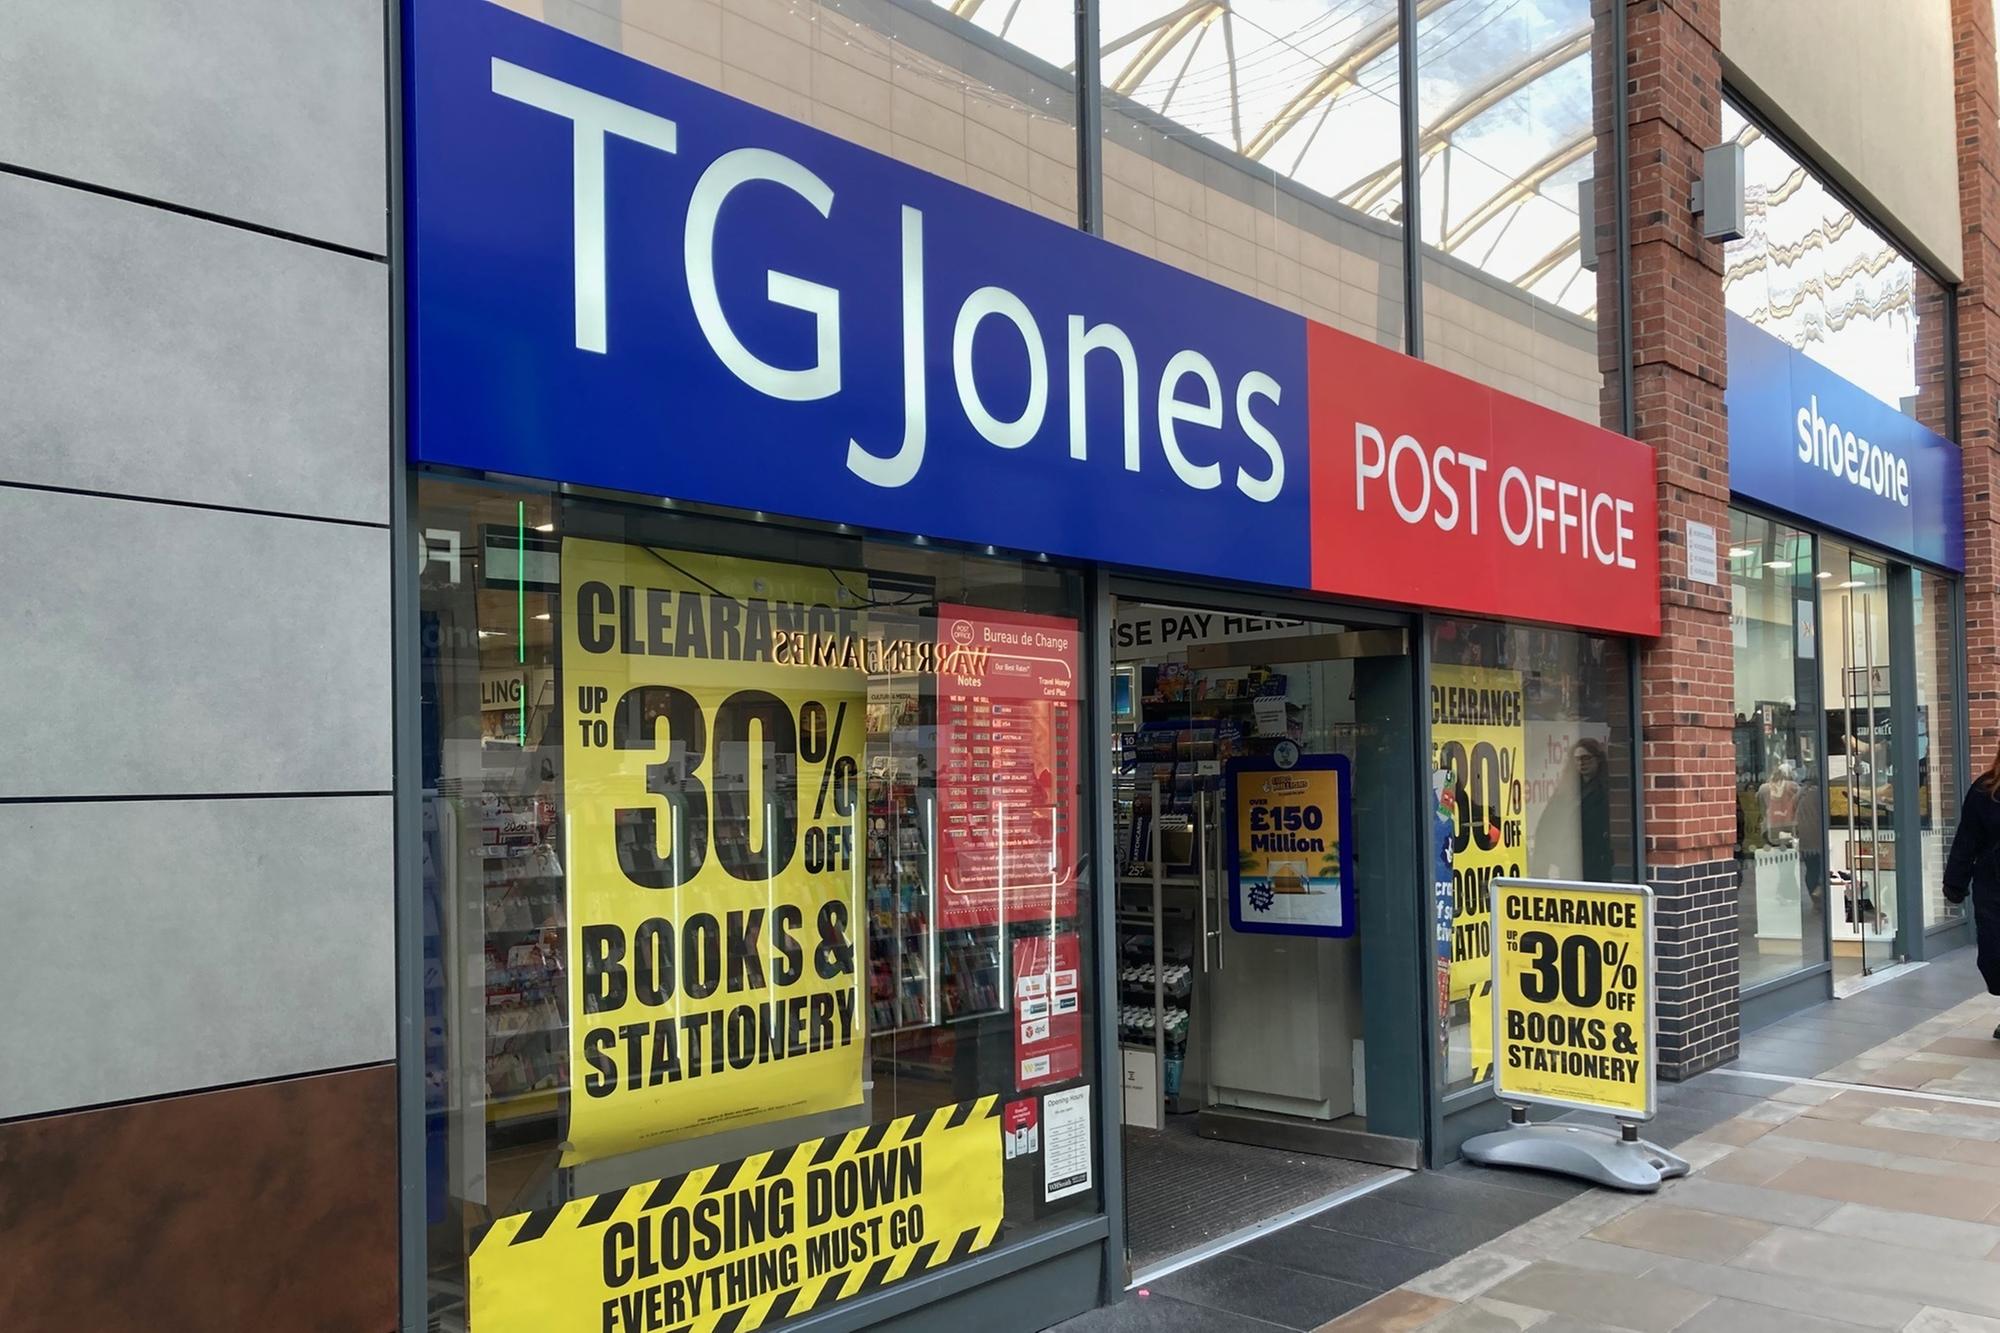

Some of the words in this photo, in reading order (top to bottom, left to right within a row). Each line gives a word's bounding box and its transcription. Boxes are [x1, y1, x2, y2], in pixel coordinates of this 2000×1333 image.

[1797, 394, 1909, 507] shoezone
[1355, 421, 1488, 536] POST
[1498, 465, 1637, 570] OFFICE
[577, 580, 858, 665] CLEARANCE
[983, 626, 1019, 645] Bureau
[1020, 631, 1033, 646] de
[1035, 632, 1069, 652] Change
[1117, 620, 1153, 647] SE
[1161, 613, 1213, 643] PAY
[1224, 615, 1305, 635] HE
[578, 685, 609, 714] UP
[957, 674, 982, 688] Notes
[1431, 684, 1521, 727] CLEARANCE
[578, 719, 608, 748] TO
[613, 684, 858, 890] 30%
[1440, 740, 1521, 854] 30%
[1250, 805, 1323, 831] £150
[1503, 820, 1521, 849] OFF
[804, 825, 856, 875] OFF
[1251, 832, 1325, 853] Million
[1451, 865, 1505, 919] OOK
[1506, 894, 1637, 929] CLEARANCE
[1506, 930, 1518, 941] UP
[1507, 940, 1519, 952] TO
[581, 901, 804, 1016] BOOKS
[815, 899, 855, 981] &
[1519, 930, 1637, 1009] 30%
[1605, 990, 1636, 1012] OFF
[582, 986, 857, 1099] STATIONERY
[1034, 1024, 1046, 1035] dpd
[1507, 1009, 1606, 1052] BOOKS
[1612, 1021, 1638, 1055] &
[1508, 1044, 1640, 1084] STATIONERY
[1047, 1095, 1069, 1108] Opening
[1069, 1093, 1084, 1101] Hours
[602, 1178, 797, 1289] CLOSING
[807, 1141, 924, 1225] DOWN
[602, 1243, 799, 1333] EVERYTHING
[806, 1219, 885, 1282] MUST
[889, 1203, 925, 1250] GO
